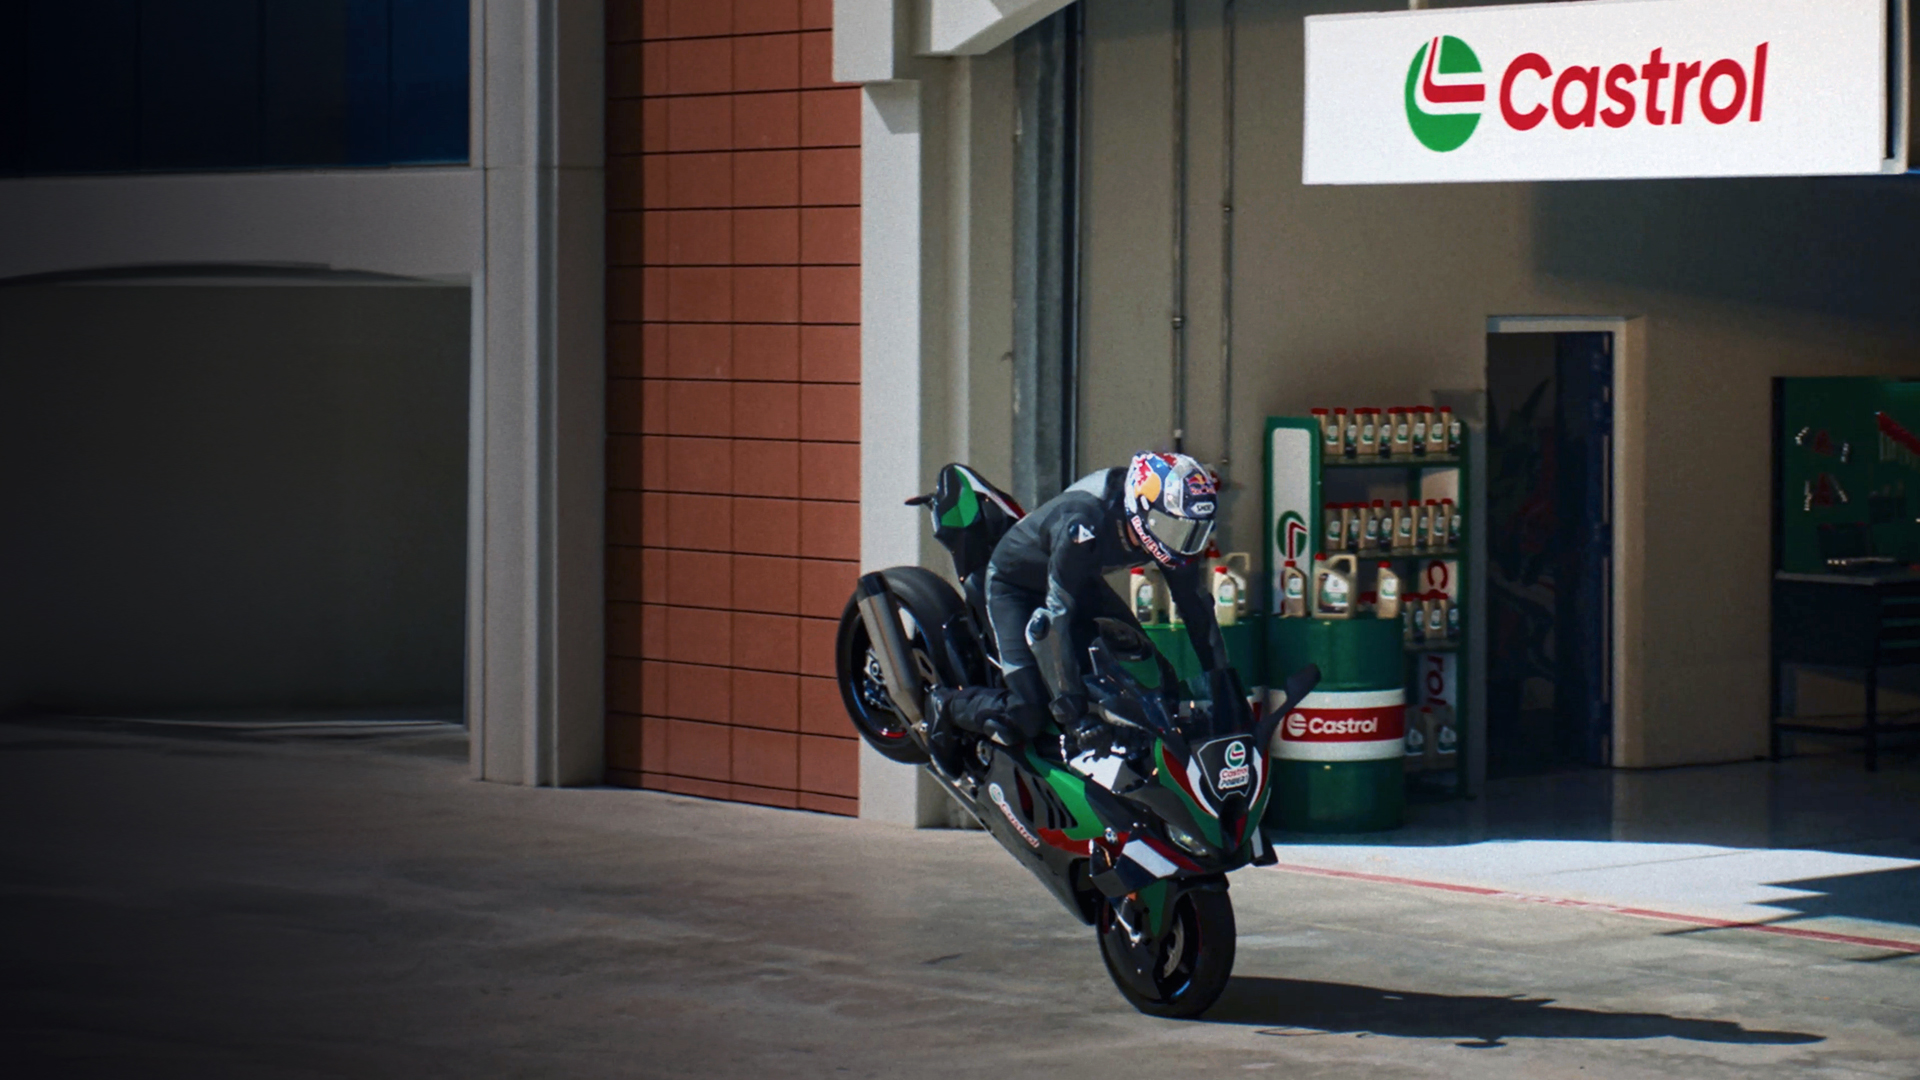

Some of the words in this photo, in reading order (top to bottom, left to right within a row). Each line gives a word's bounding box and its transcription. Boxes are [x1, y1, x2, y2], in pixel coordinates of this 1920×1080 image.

[1499, 41, 1769, 131] Castrol
[1131, 515, 1150, 545] Red
[1146, 540, 1171, 563] Bull
[1308, 716, 1378, 735] Castrol
[1221, 764, 1249, 779] Castrol
[1000, 801, 1039, 847] Castrol
